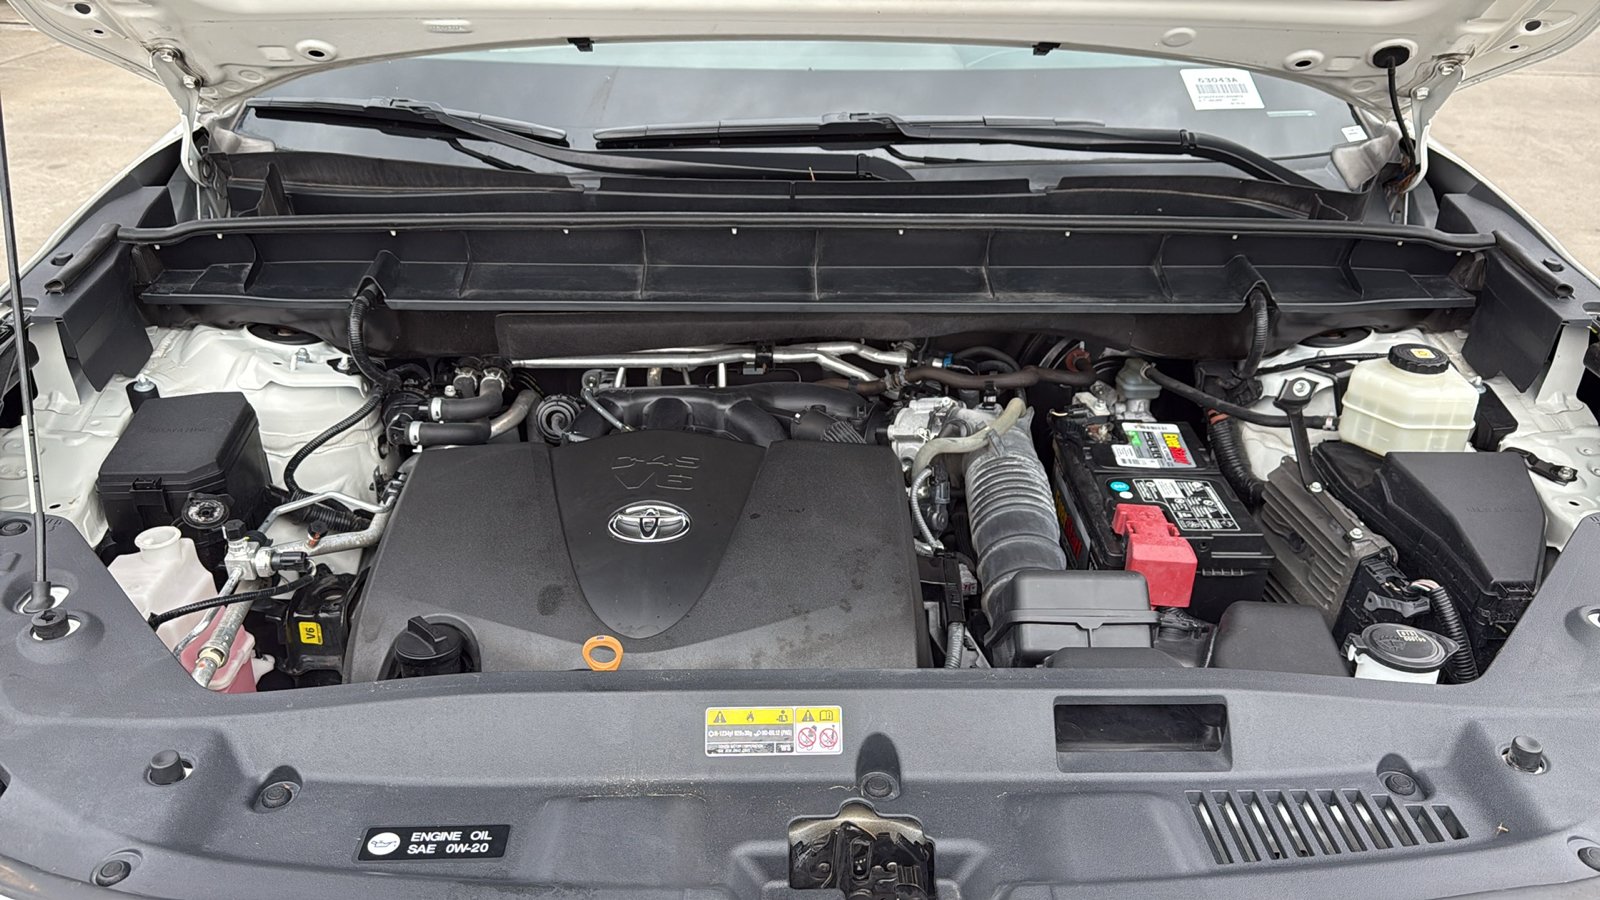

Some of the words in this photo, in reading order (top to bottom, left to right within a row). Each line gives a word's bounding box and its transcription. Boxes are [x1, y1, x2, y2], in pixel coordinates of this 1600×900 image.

[614, 471, 694, 491] V6
[305, 626, 316, 640] V6
[410, 831, 463, 842] ENGINE
[470, 830, 493, 841] OIL
[407, 844, 437, 855] SAE
[445, 842, 490, 853] 0W-20
